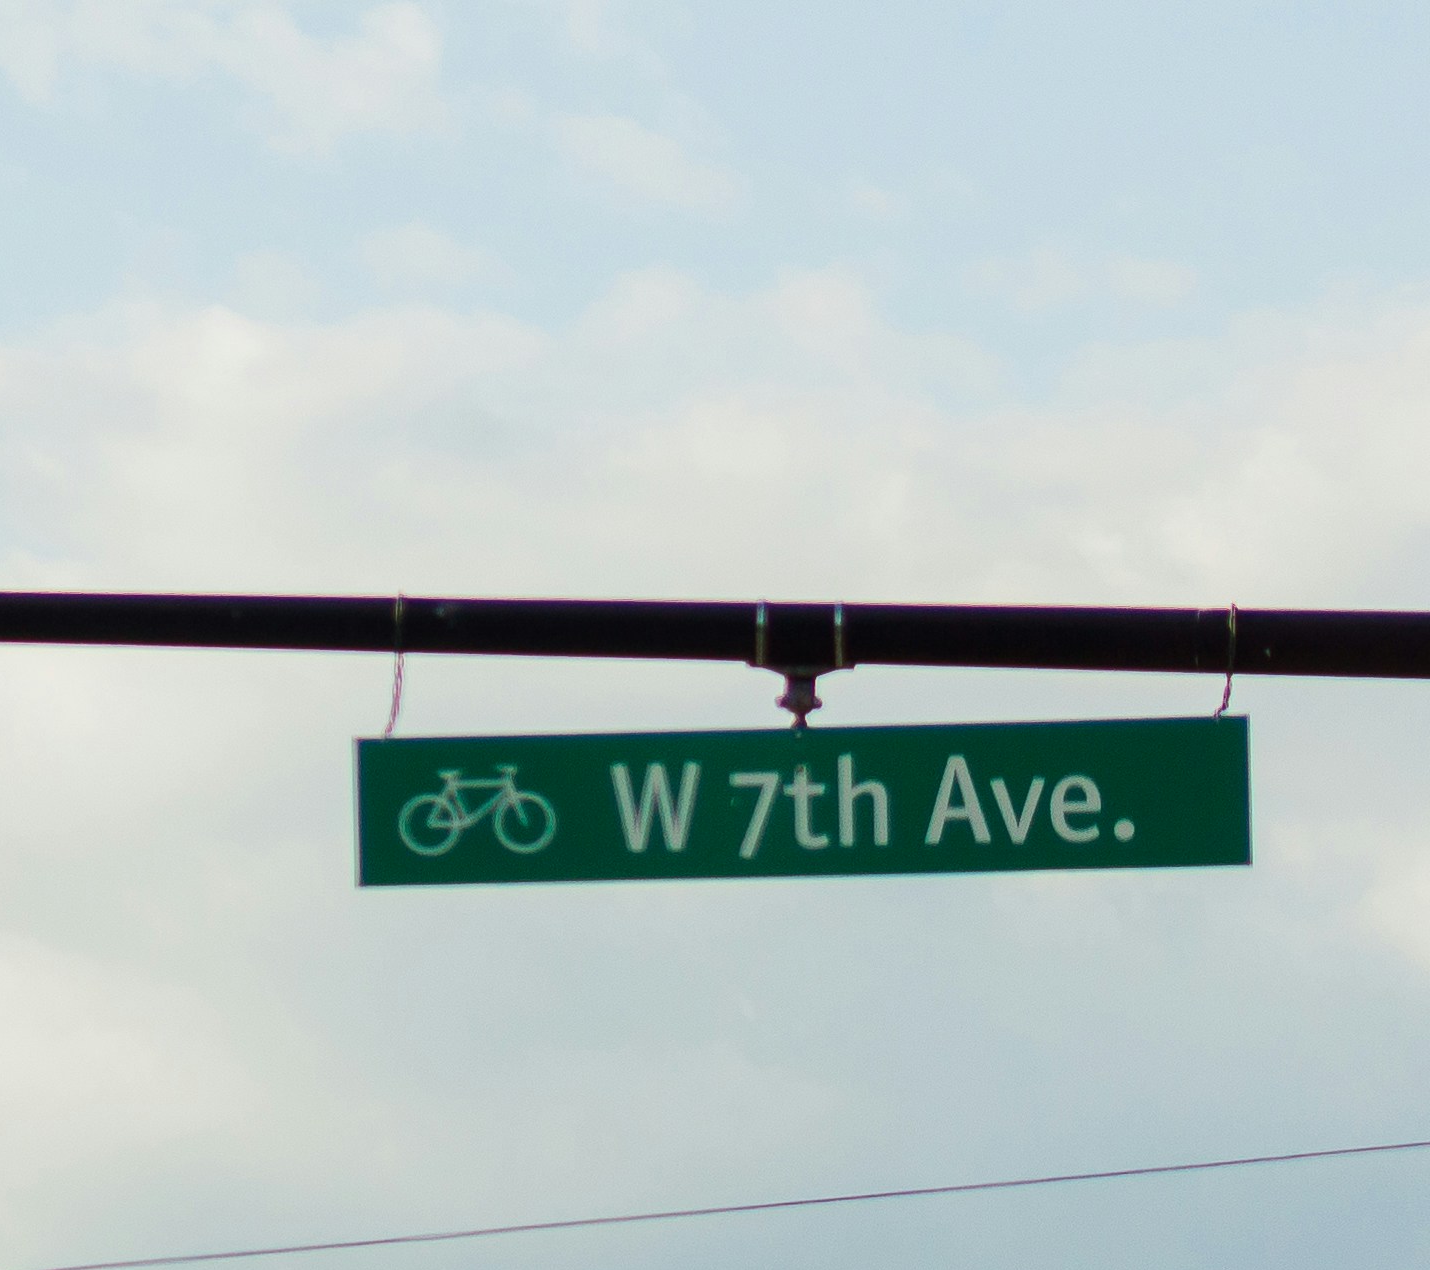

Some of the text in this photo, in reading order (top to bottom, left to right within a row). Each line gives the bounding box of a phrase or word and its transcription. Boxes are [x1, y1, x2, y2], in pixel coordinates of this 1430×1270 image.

[610, 753, 1137, 858] W 7th Ave.
